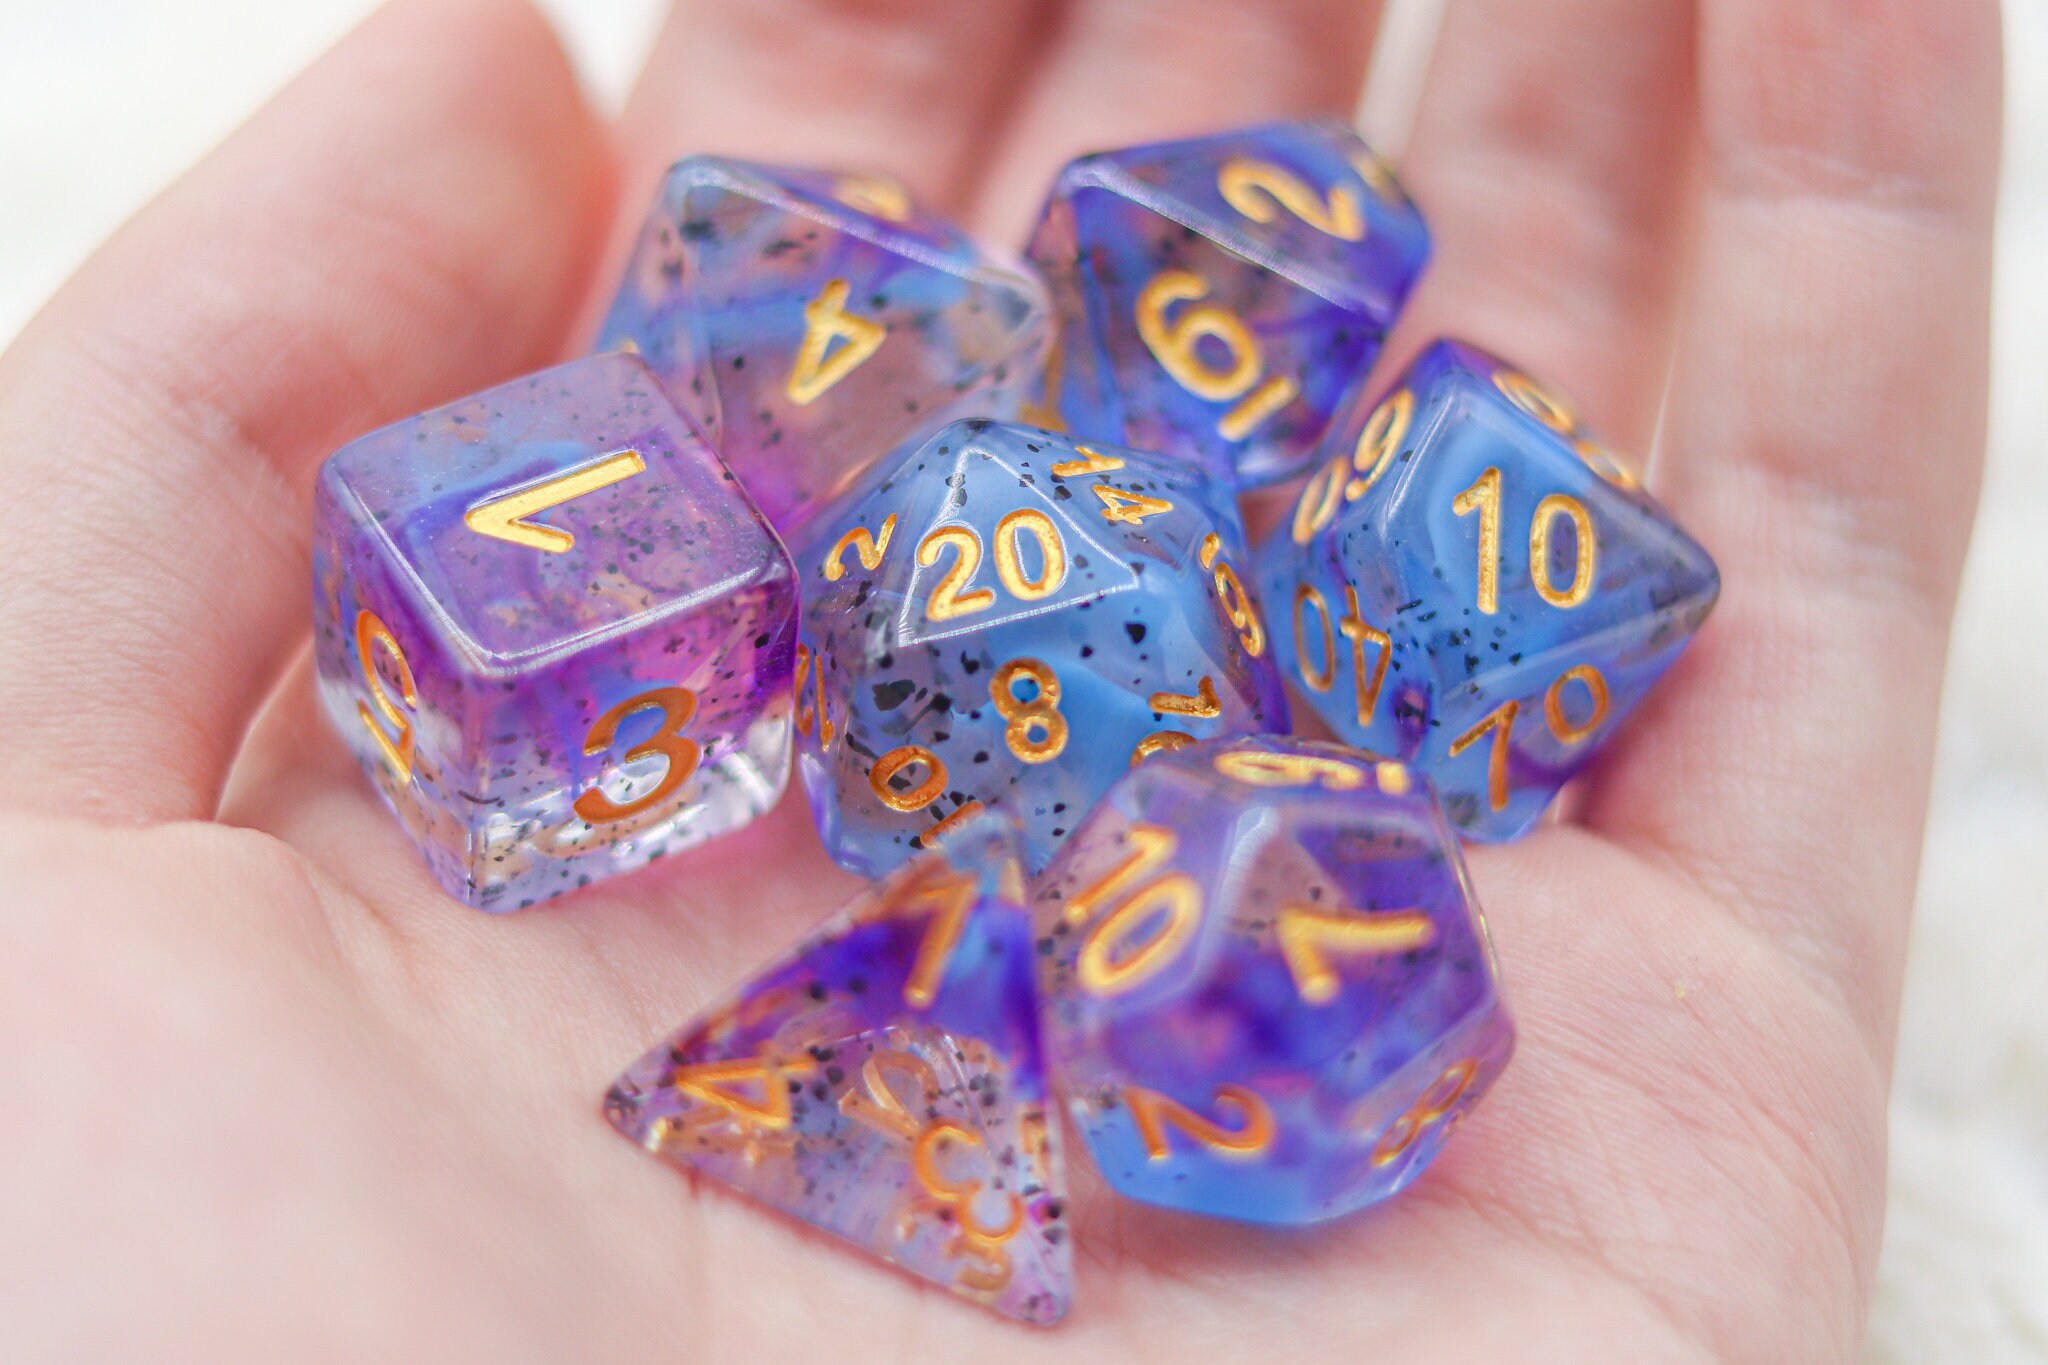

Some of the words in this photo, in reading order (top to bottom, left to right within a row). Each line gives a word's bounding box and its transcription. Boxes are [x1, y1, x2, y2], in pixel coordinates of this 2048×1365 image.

[1218, 156, 1366, 243] 2
[787, 277, 888, 405] 4
[825, 512, 898, 582] 2
[917, 507, 1066, 623] 20
[1453, 466, 1597, 615] 10
[572, 685, 701, 826] 3
[989, 656, 1070, 765] 8
[1062, 822, 1204, 997] 10
[677, 1047, 818, 1129] 4
[1123, 1083, 1278, 1168] 2
[1370, 1057, 1479, 1169] 8
[914, 1116, 1024, 1245] 3
